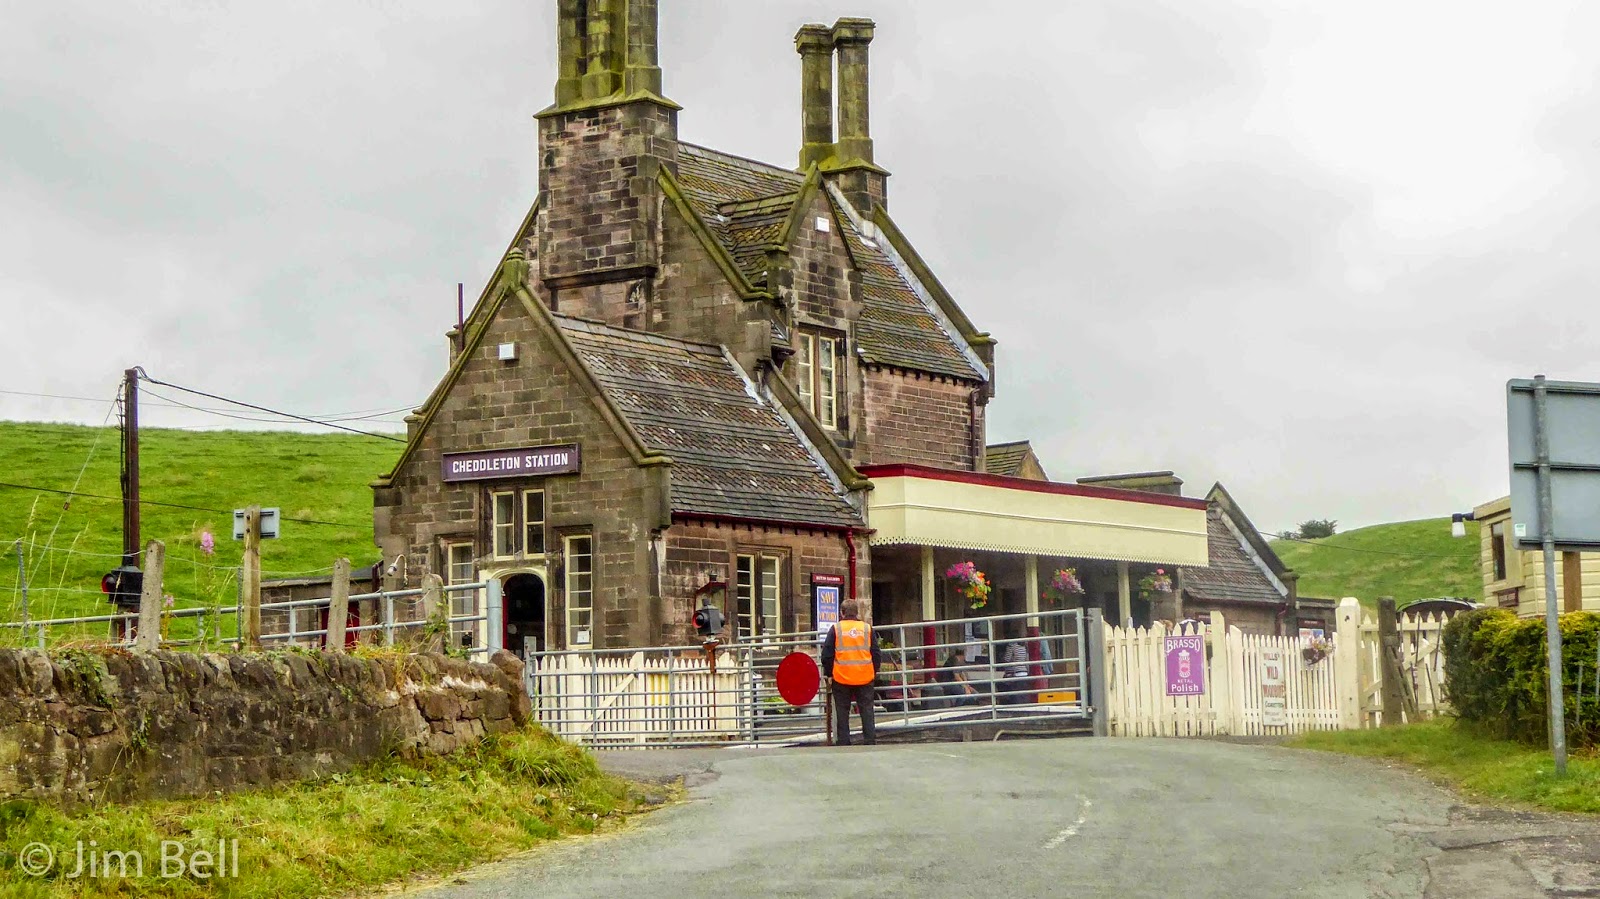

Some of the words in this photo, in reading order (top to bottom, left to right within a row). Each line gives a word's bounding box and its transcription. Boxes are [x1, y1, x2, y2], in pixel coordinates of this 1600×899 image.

[452, 456, 520, 473] CHEDDLETON
[525, 453, 568, 468] STATION
[820, 591, 836, 604] SAVE
[1166, 638, 1201, 653] BRASSO
[1171, 683, 1199, 693] Polish
